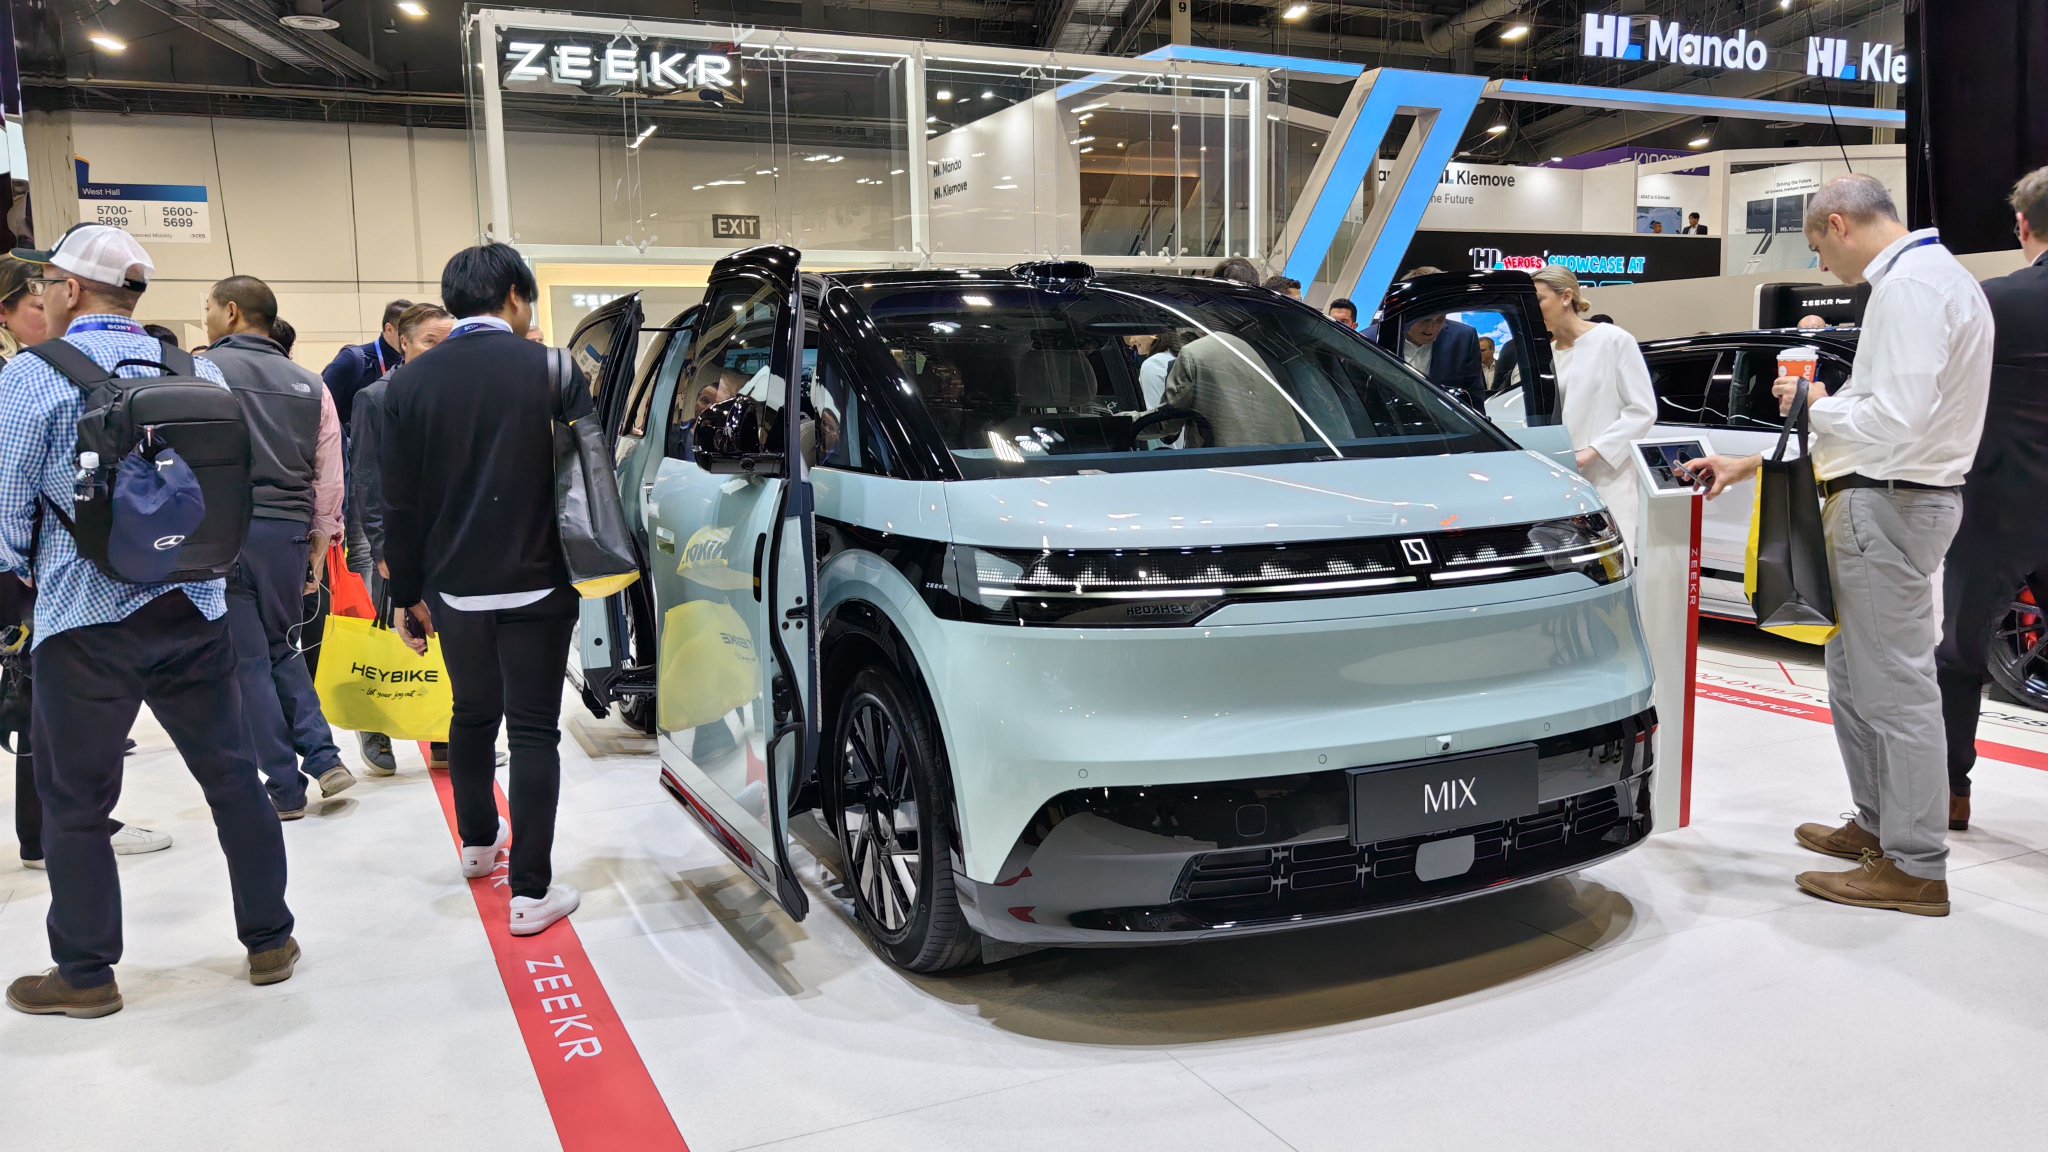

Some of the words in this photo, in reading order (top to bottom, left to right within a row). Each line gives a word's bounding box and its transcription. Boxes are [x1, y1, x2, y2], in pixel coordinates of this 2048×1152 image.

[1178, 1, 1187, 13] 9
[1648, 19, 1768, 71] Mando
[508, 41, 735, 88] ZEEKR
[1860, 41, 1906, 84] Kle
[942, 159, 962, 175] Mando
[1456, 169, 1516, 187] Klemove
[82, 188, 103, 196] West
[105, 189, 120, 197] Hall
[943, 181, 968, 197] Klemove
[1444, 193, 1474, 205] Future
[97, 205, 133, 216] 5700-
[162, 206, 199, 217] 5600-
[98, 216, 129, 226] 5899
[163, 218, 193, 228] 5699
[717, 218, 757, 236] EXIT
[1548, 255, 1624, 274] SHOWCASE
[1627, 256, 1646, 274] AT
[1802, 299, 1834, 307] ZEEKR
[107, 323, 132, 331] SONY
[1689, 546, 1699, 606] ZEEKR
[925, 582, 949, 590] ZEEKR
[351, 662, 438, 683] HEYBIKE
[376, 691, 391, 699] your
[1706, 691, 1815, 715] supercar
[1424, 776, 1478, 814] MIX
[525, 954, 603, 1064] ZEEKR
